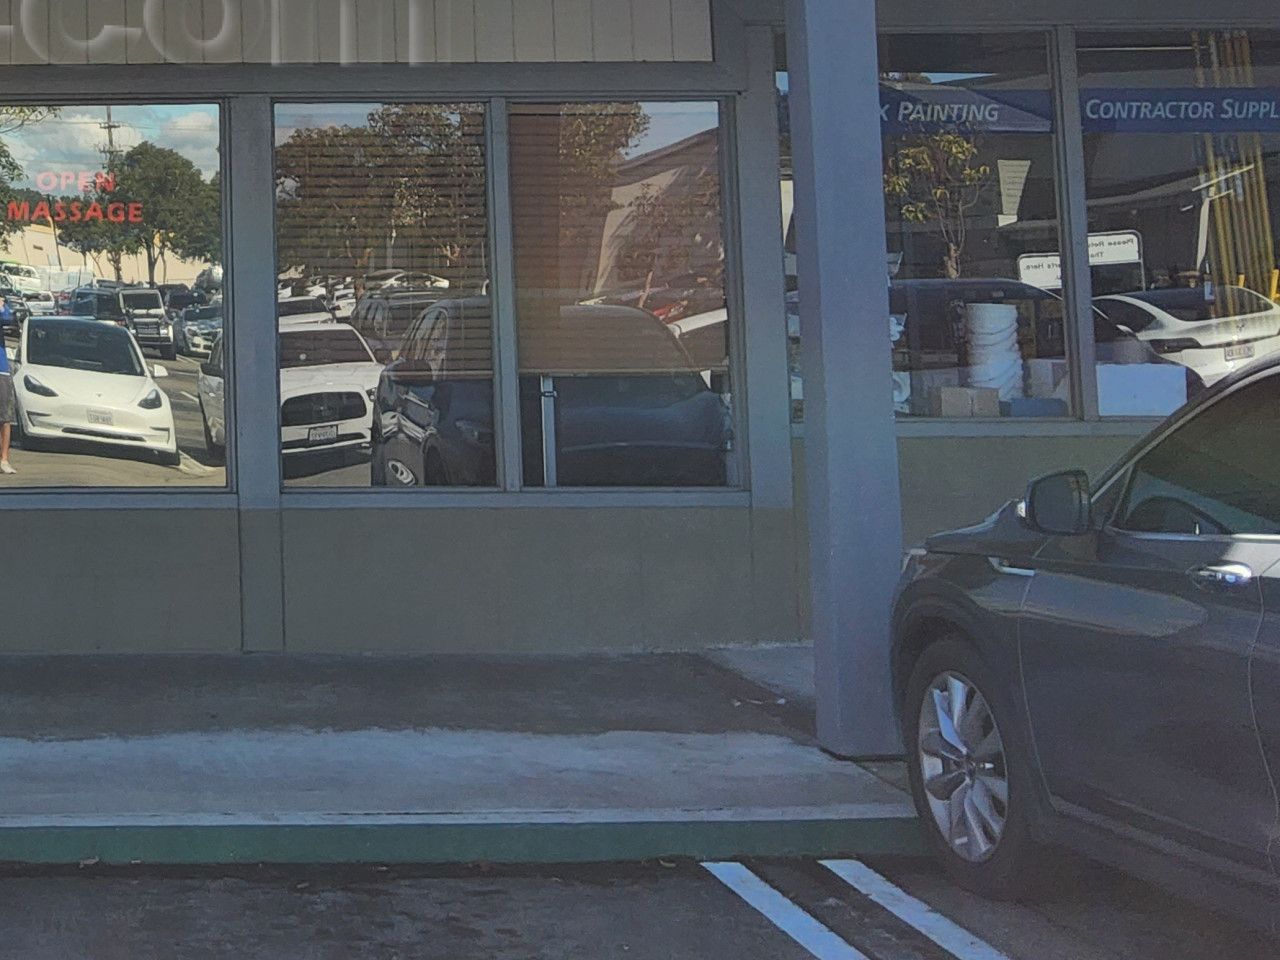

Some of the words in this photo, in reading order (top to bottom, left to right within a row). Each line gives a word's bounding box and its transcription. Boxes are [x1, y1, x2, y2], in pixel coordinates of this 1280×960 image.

[898, 101, 999, 122] PAINTING
[1085, 98, 1215, 120] CONTRACTOR
[36, 170, 116, 192] OPEN
[6, 200, 144, 223] MASSAGE
